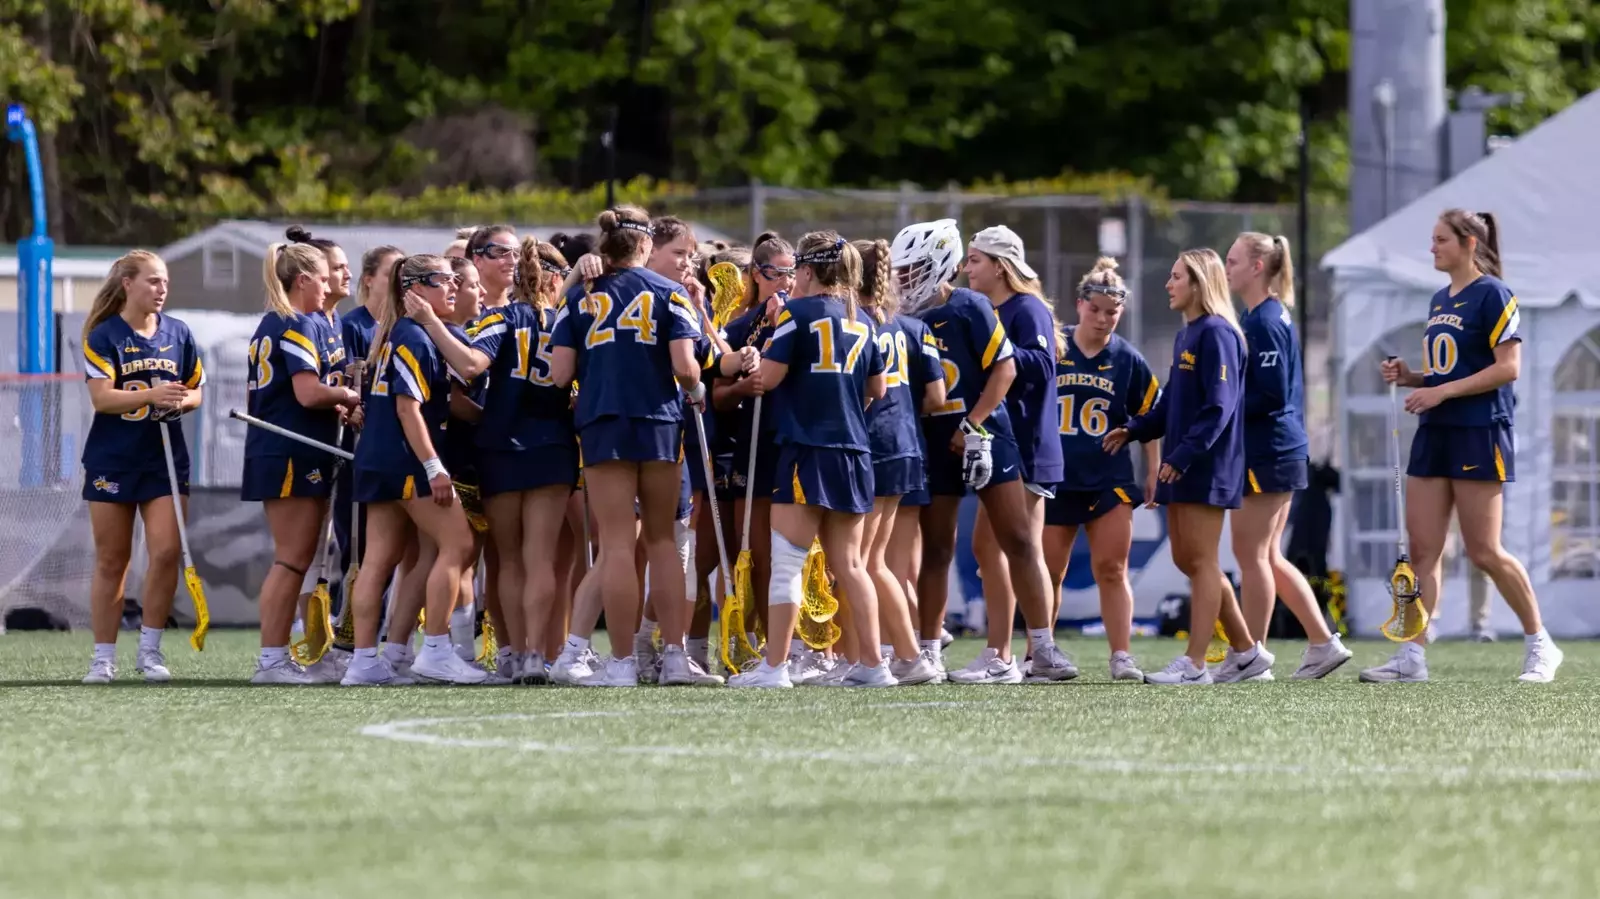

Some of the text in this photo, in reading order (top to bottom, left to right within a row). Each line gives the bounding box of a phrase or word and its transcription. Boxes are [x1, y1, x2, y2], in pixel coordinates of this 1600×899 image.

[578, 290, 657, 350] 24
[510, 326, 552, 387] 15
[809, 317, 869, 375] 17
[1037, 335, 1048, 349] 9
[1259, 350, 1279, 368] 27
[1422, 332, 1459, 376] 10
[121, 357, 178, 377] DREXEL
[1220, 364, 1228, 382] 1
[1056, 372, 1116, 397] DREXEL
[1057, 393, 1112, 438] 16
